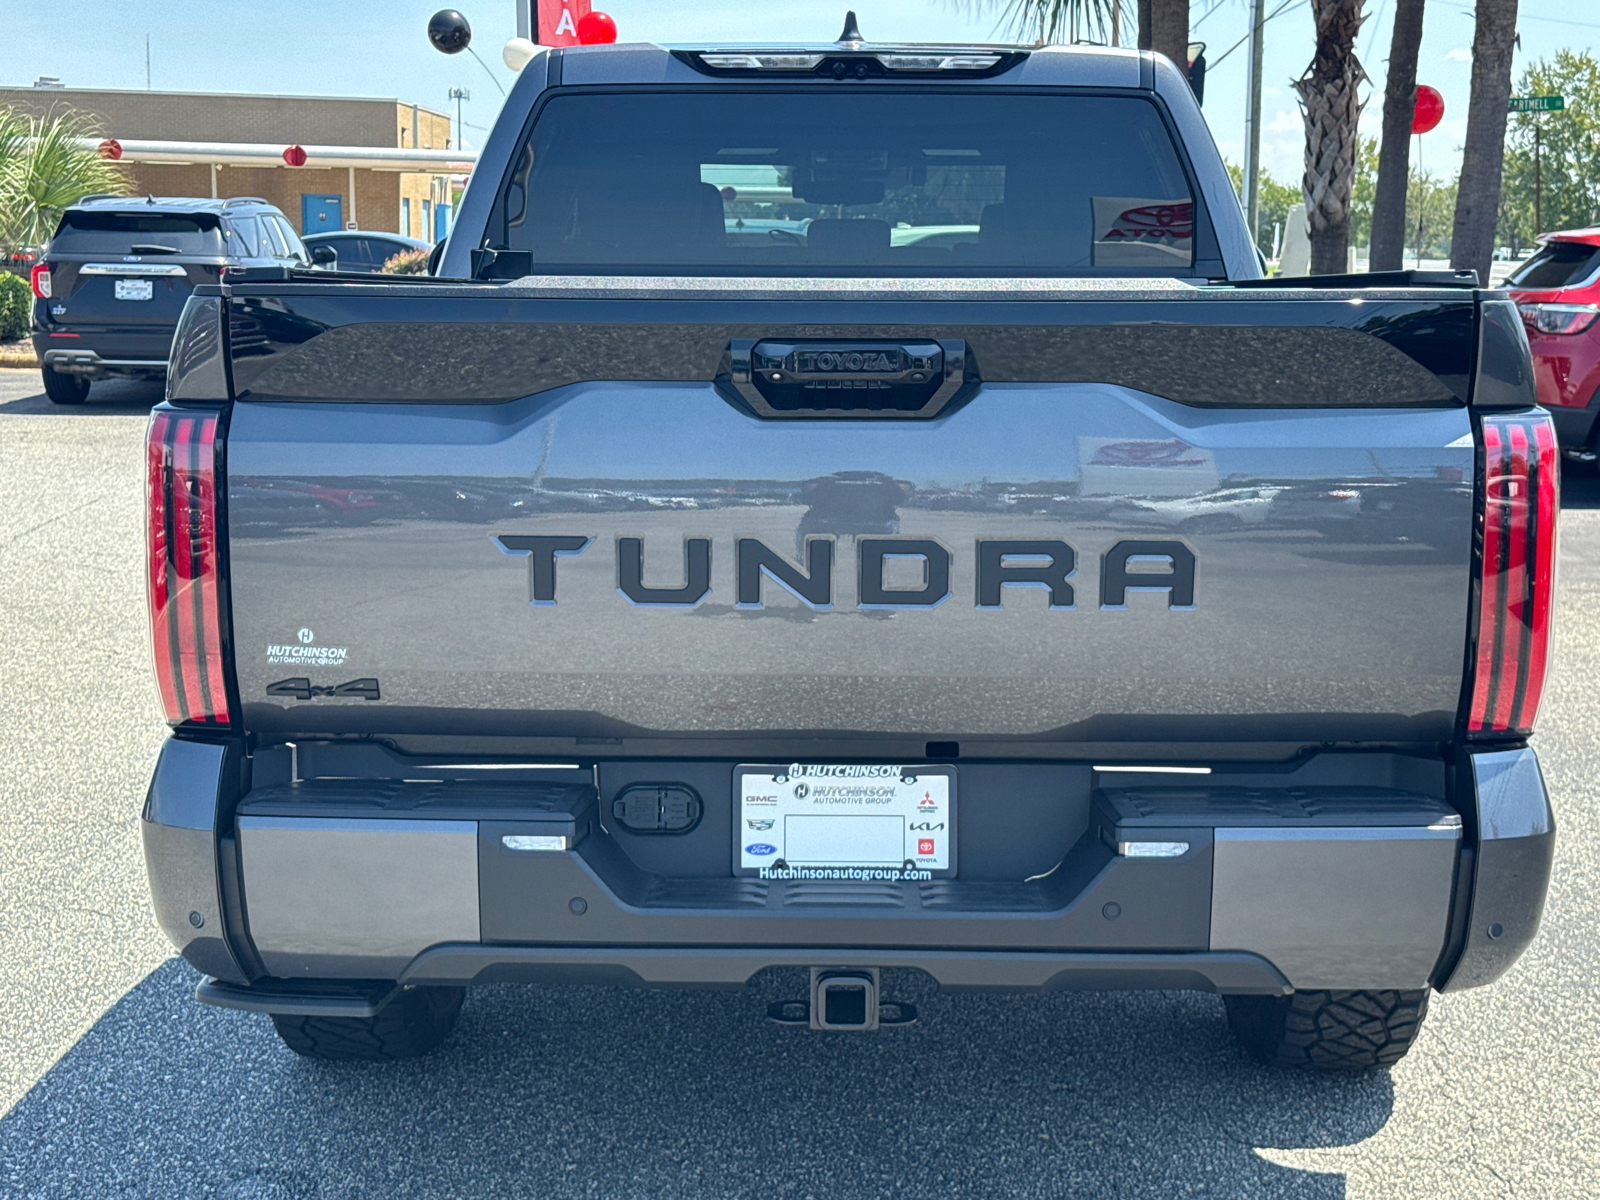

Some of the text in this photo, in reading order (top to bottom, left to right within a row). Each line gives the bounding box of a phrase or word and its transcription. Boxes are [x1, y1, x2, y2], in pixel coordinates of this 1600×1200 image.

[555, 0, 577, 37] A
[804, 352, 891, 371] TOYOTA
[490, 534, 1198, 610] TUNDRA
[267, 645, 346, 659] HUTCHINSON
[268, 656, 316, 664] AUTOMOTIVE
[805, 765, 902, 778] HUTCHINSON
[812, 786, 897, 797] HUTCHINSON
[750, 844, 772, 854] Ford
[760, 867, 932, 882] Hutchinsonautogroup.com
